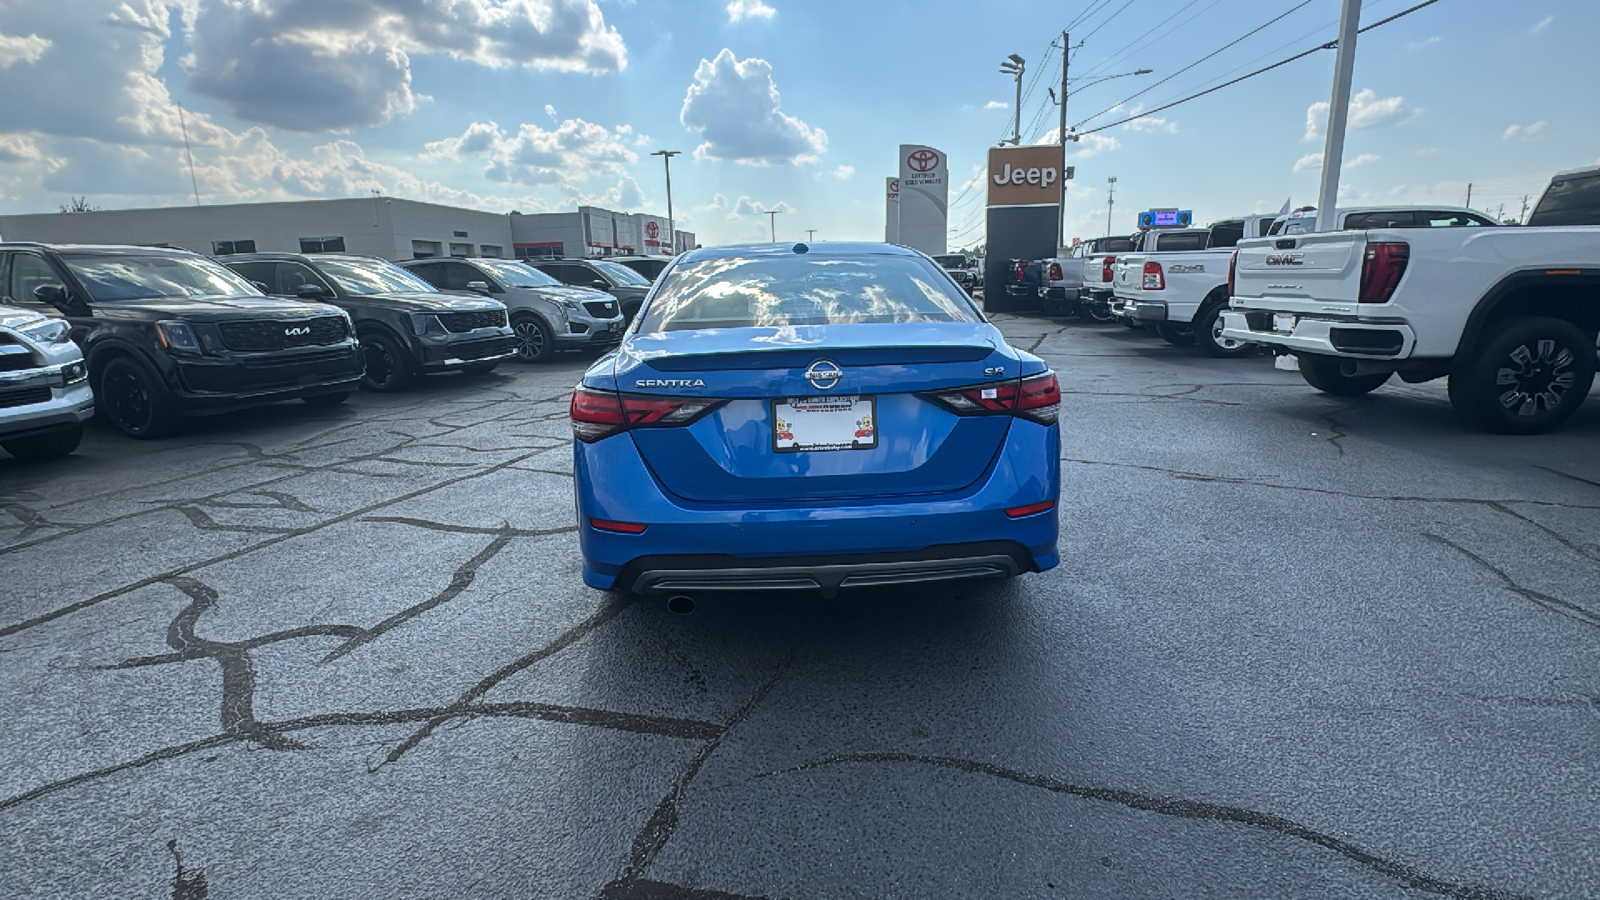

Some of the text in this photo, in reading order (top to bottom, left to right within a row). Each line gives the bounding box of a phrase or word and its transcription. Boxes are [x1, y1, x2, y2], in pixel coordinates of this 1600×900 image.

[993, 163, 1057, 188] Jeep
[1266, 253, 1306, 265] GMC
[984, 366, 1005, 376] SR
[635, 378, 706, 389] SENTRA
